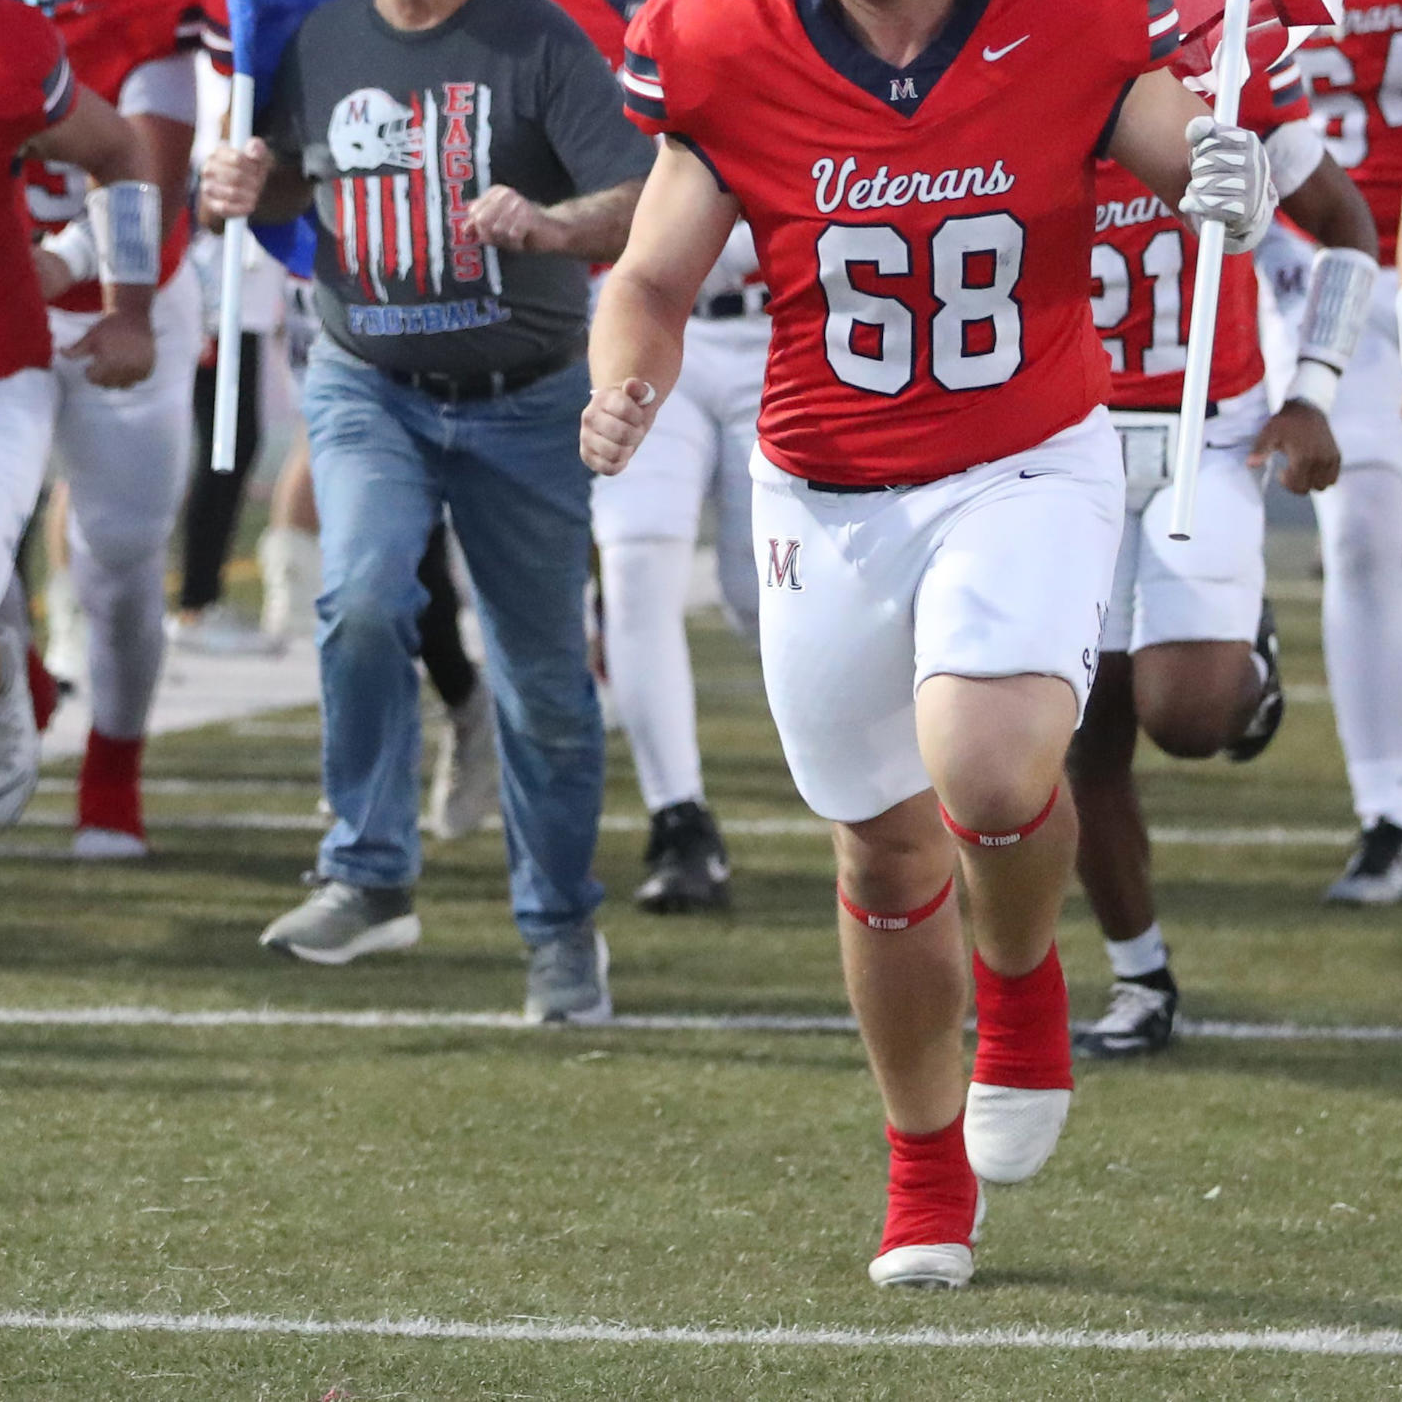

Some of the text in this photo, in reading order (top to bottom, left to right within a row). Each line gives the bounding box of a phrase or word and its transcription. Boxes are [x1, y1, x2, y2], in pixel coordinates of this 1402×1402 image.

[350, 100, 370, 124] M
[889, 77, 919, 101] M
[811, 156, 1016, 214] Veterans
[815, 209, 1027, 398] 68
[766, 537, 803, 591] M
